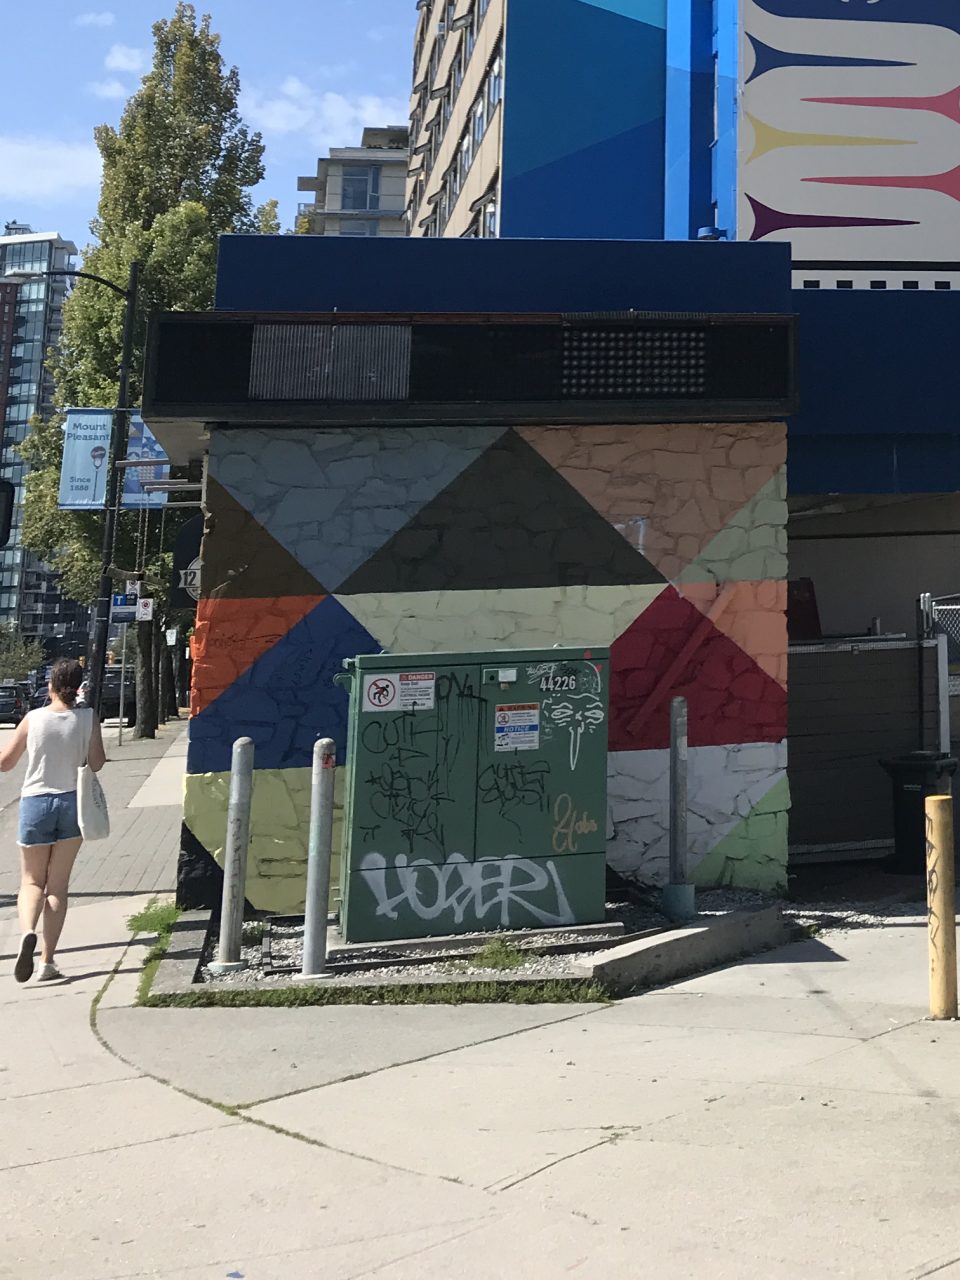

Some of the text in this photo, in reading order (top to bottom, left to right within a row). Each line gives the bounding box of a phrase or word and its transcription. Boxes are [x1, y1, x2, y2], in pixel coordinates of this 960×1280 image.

[72, 422, 107, 431] Mount
[66, 432, 110, 441] Pleasant
[182, 570, 197, 587] 12
[540, 675, 576, 692] 44226
[503, 725, 529, 733] NOTICE
